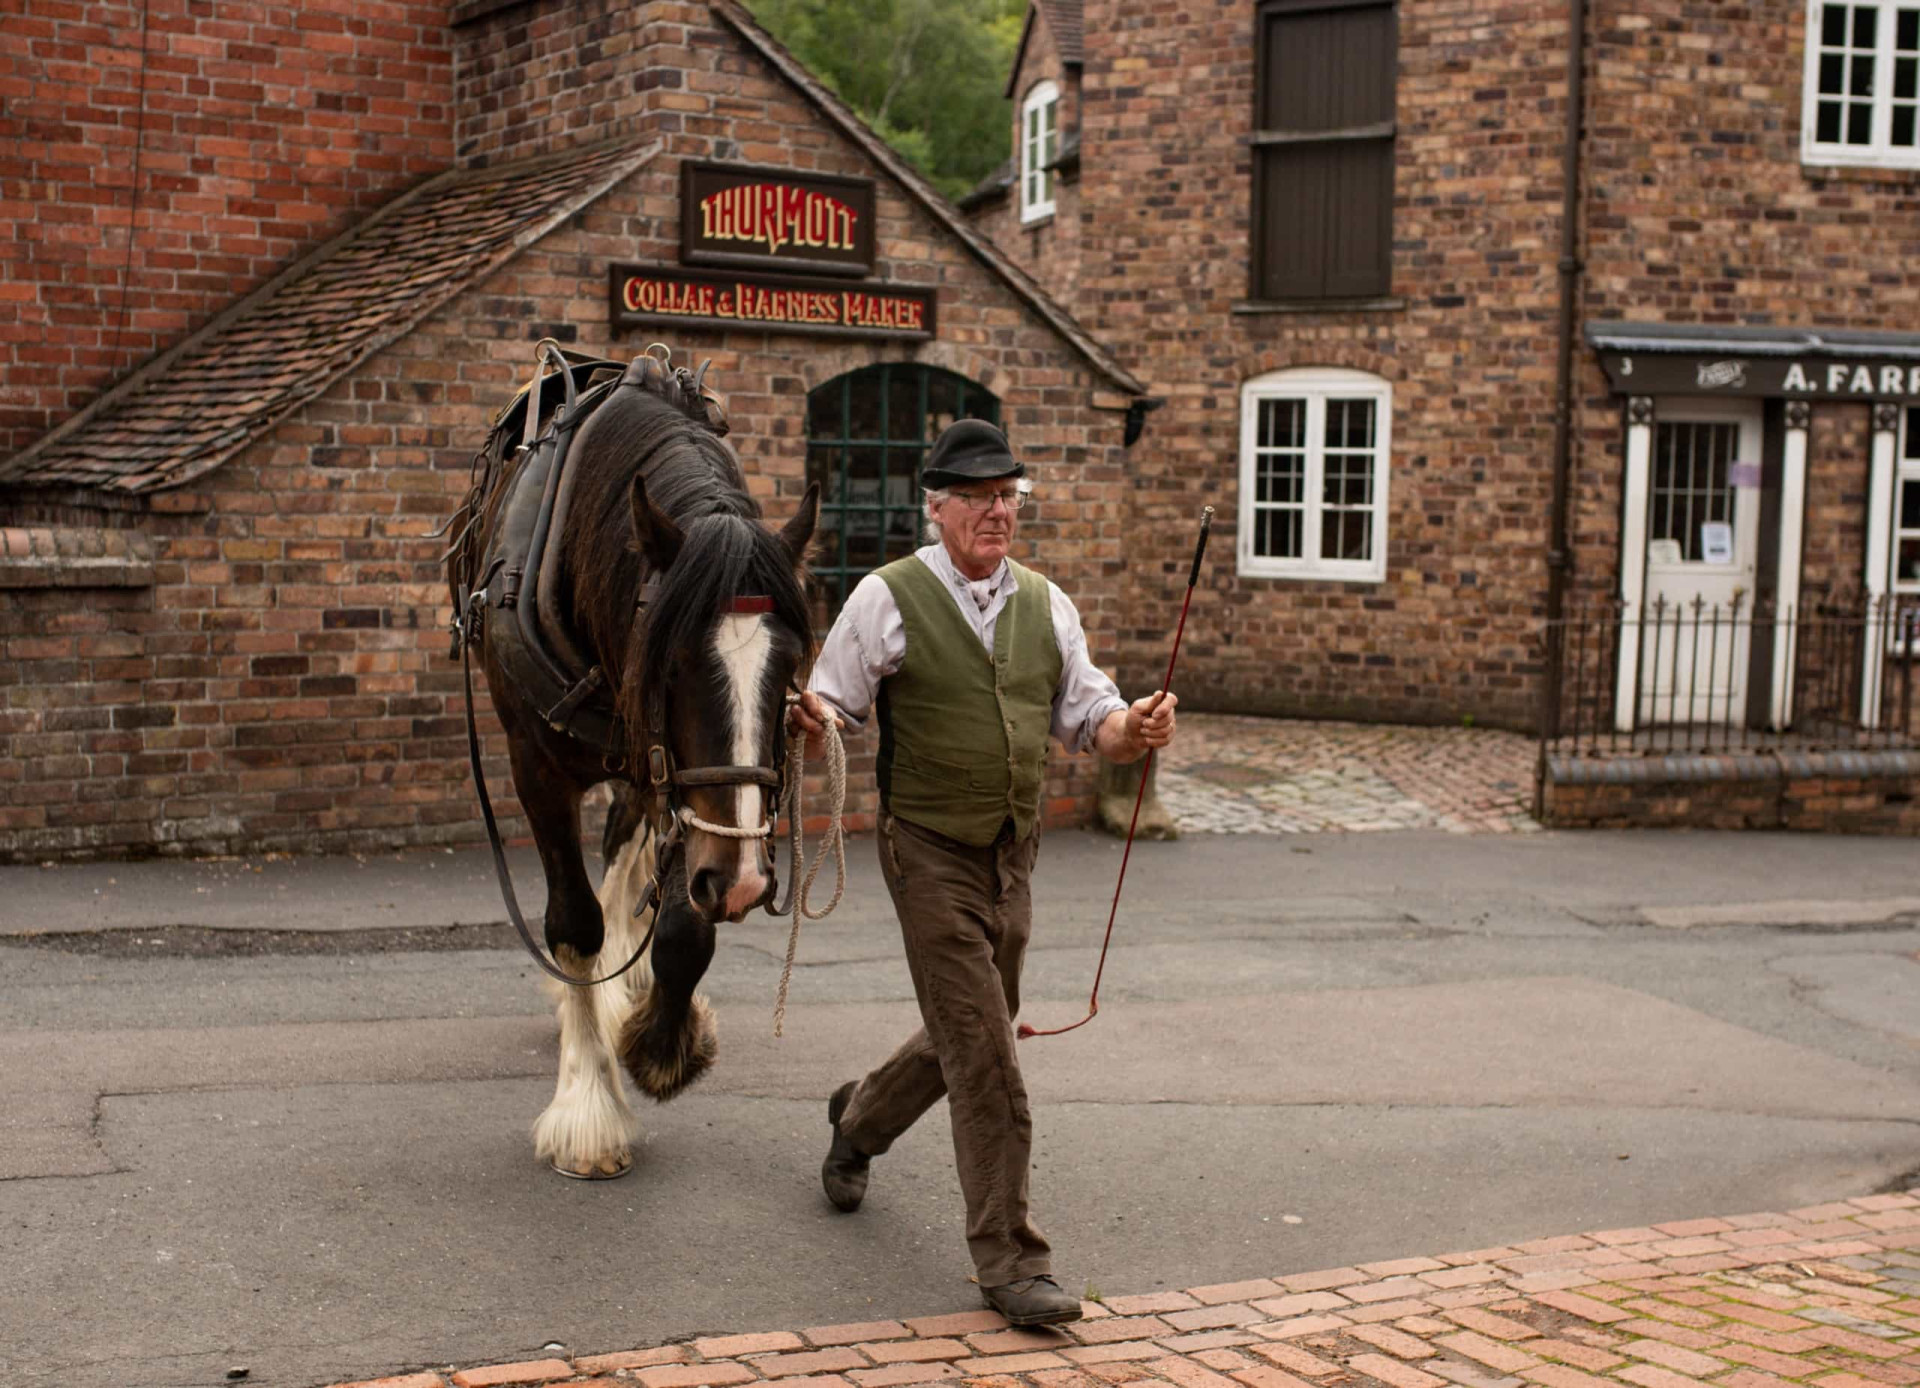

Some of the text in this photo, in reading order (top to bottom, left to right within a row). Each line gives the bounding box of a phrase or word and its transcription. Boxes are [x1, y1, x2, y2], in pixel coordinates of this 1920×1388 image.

[701, 184, 858, 254] THURMOTT
[623, 276, 924, 330] COLLAR & HARNESS MAKER
[1782, 362, 1818, 392] A.
